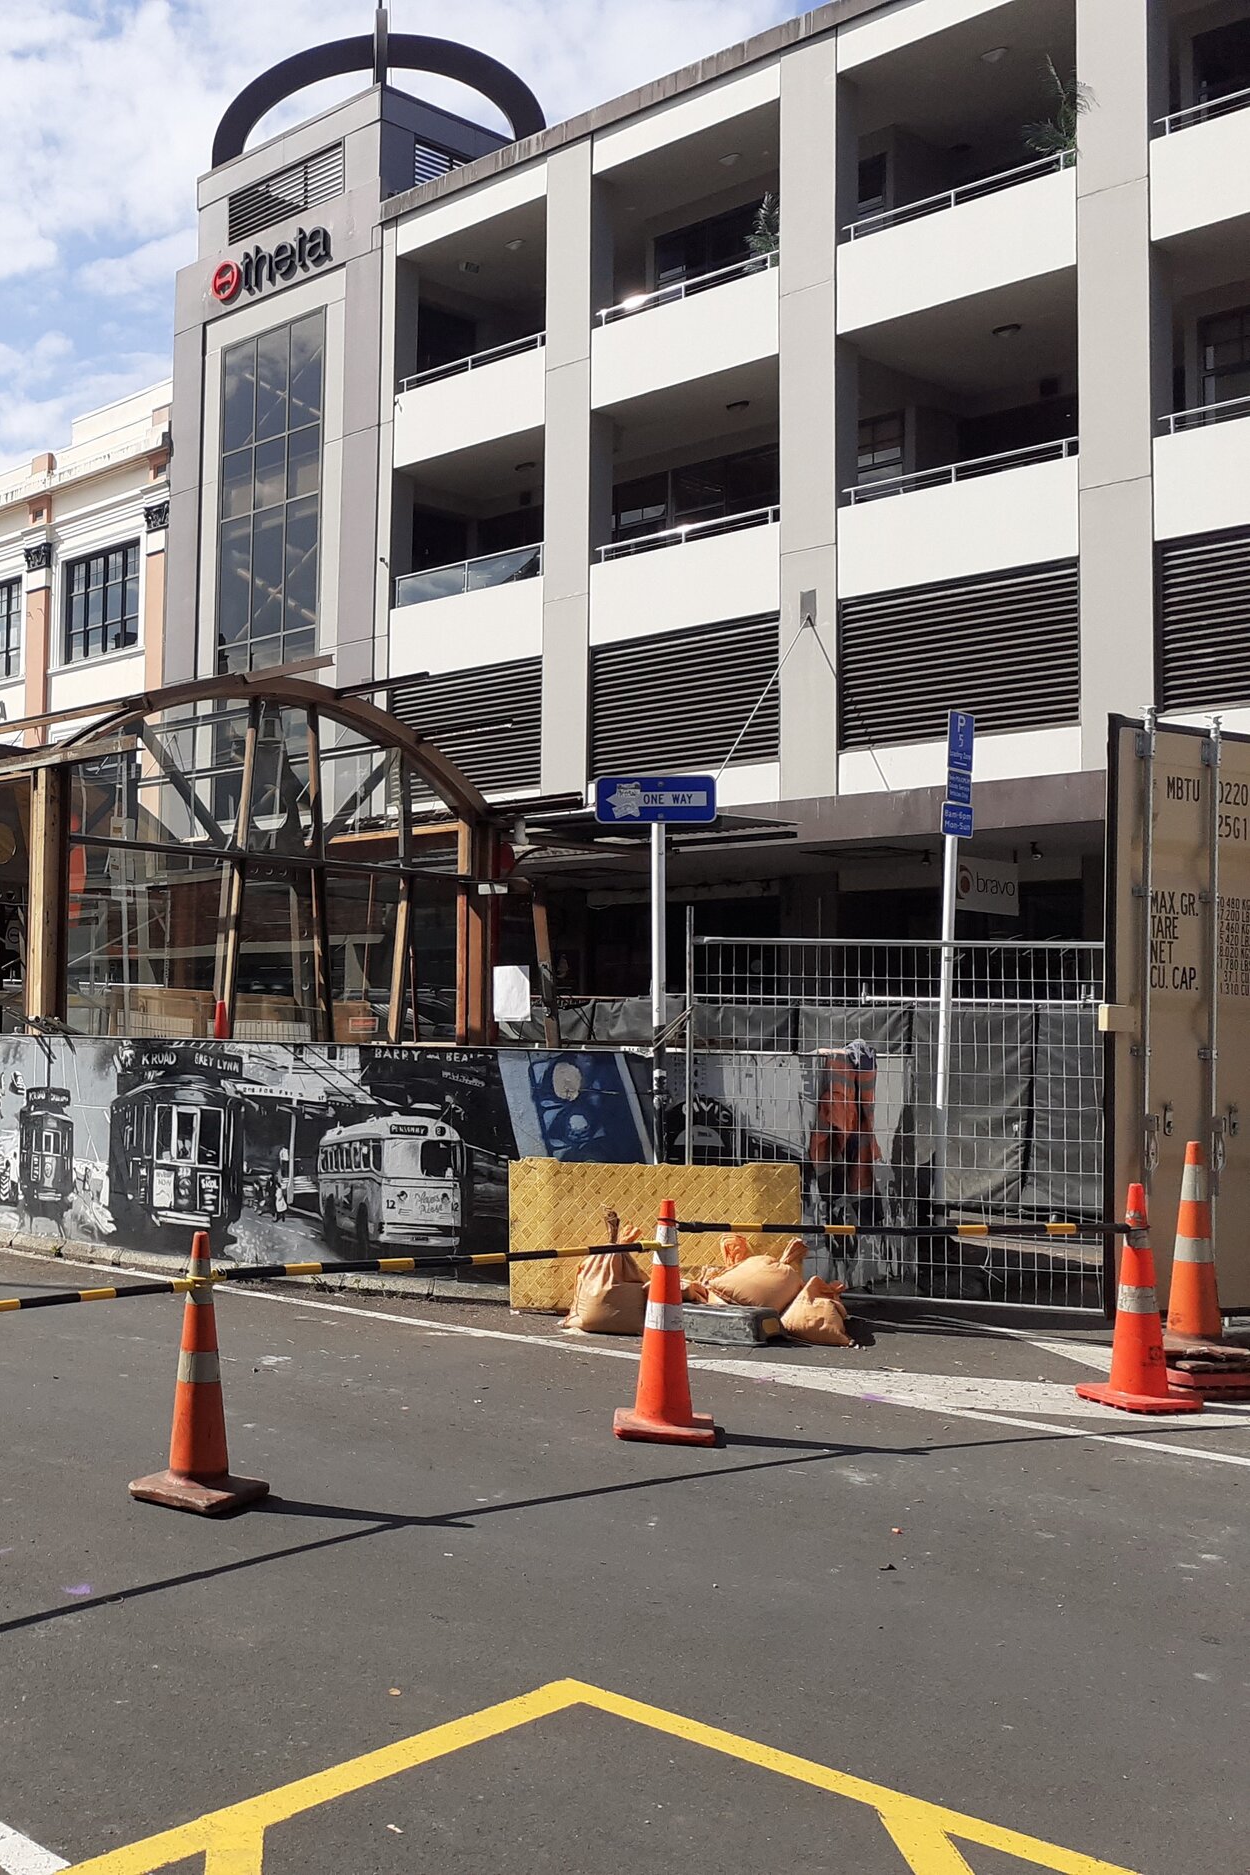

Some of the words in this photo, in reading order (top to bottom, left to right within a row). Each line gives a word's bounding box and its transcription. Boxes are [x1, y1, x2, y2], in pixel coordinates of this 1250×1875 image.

[241, 226, 332, 296] theta
[957, 715, 966, 732] P
[959, 735, 964, 747] 5
[1167, 776, 1200, 802] MBTU
[643, 794, 664, 805] ONE
[672, 794, 693, 804] WAY
[945, 809, 971, 820] 8am-6pm
[945, 820, 970, 830] Mon-Sun
[1218, 815, 1247, 840] 25G1
[976, 872, 1016, 896] bravo
[1151, 915, 1179, 939] TARE
[1150, 940, 1174, 964] NET
[1150, 965, 1168, 989] CU.
[1172, 966, 1199, 990] CAP.
[141, 1053, 149, 1065] K
[151, 1051, 177, 1065] ROAD
[194, 1052, 214, 1067] GREY
[217, 1059, 239, 1073] LYNN
[375, 1048, 421, 1061] BARRY
[386, 1200, 396, 1209] 12
